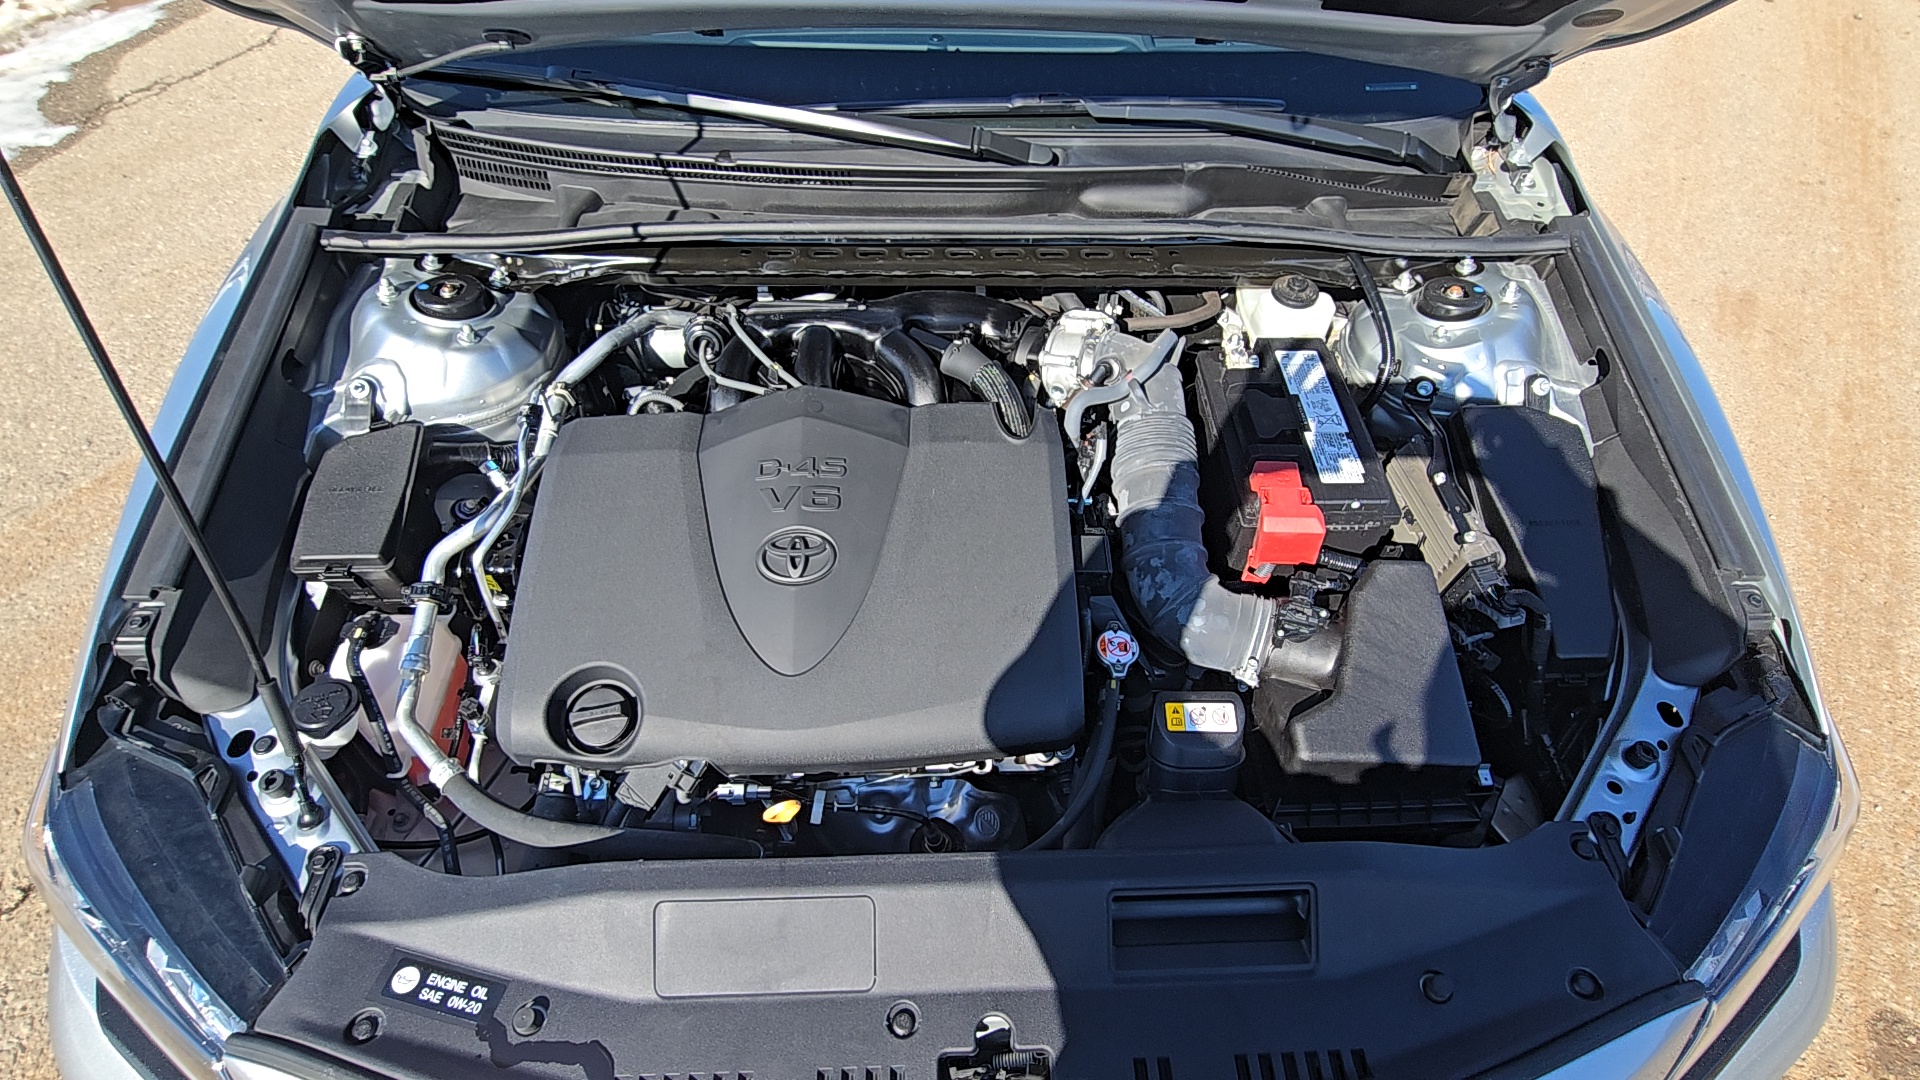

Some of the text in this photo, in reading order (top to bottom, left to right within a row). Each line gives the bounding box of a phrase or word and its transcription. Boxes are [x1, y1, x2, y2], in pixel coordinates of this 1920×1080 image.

[759, 484, 842, 512] V6
[426, 973, 488, 1000] ENGINE OIL
[418, 988, 482, 1014] SAE 0W-20
